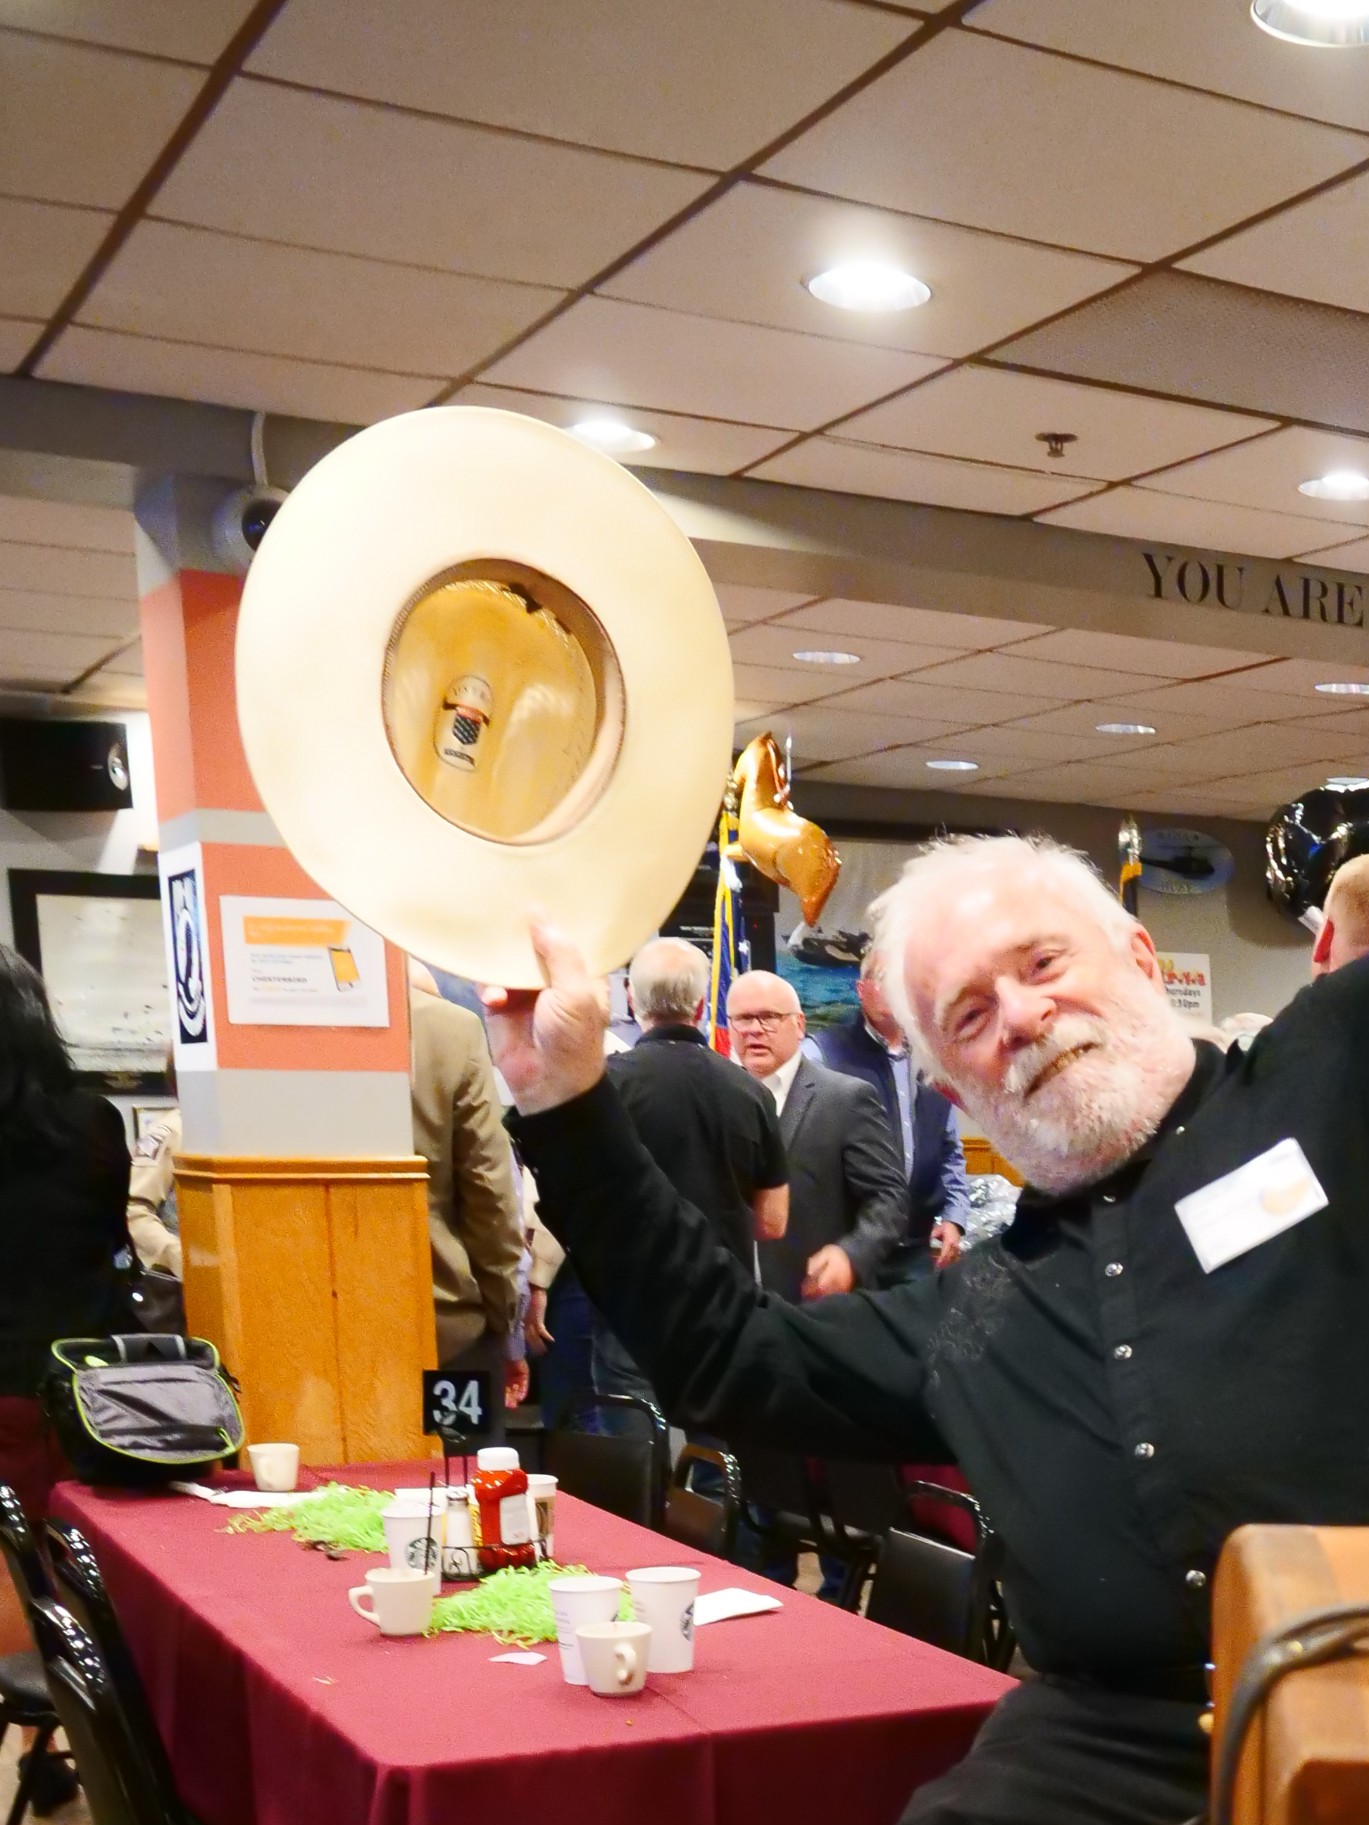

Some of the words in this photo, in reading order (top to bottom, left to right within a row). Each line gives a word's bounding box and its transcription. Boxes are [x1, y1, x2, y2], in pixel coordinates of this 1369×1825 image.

[1142, 552, 1246, 611] YOU
[1260, 574, 1365, 627] ARE
[1164, 986, 1202, 998] hursdays
[432, 1380, 483, 1426] 34
